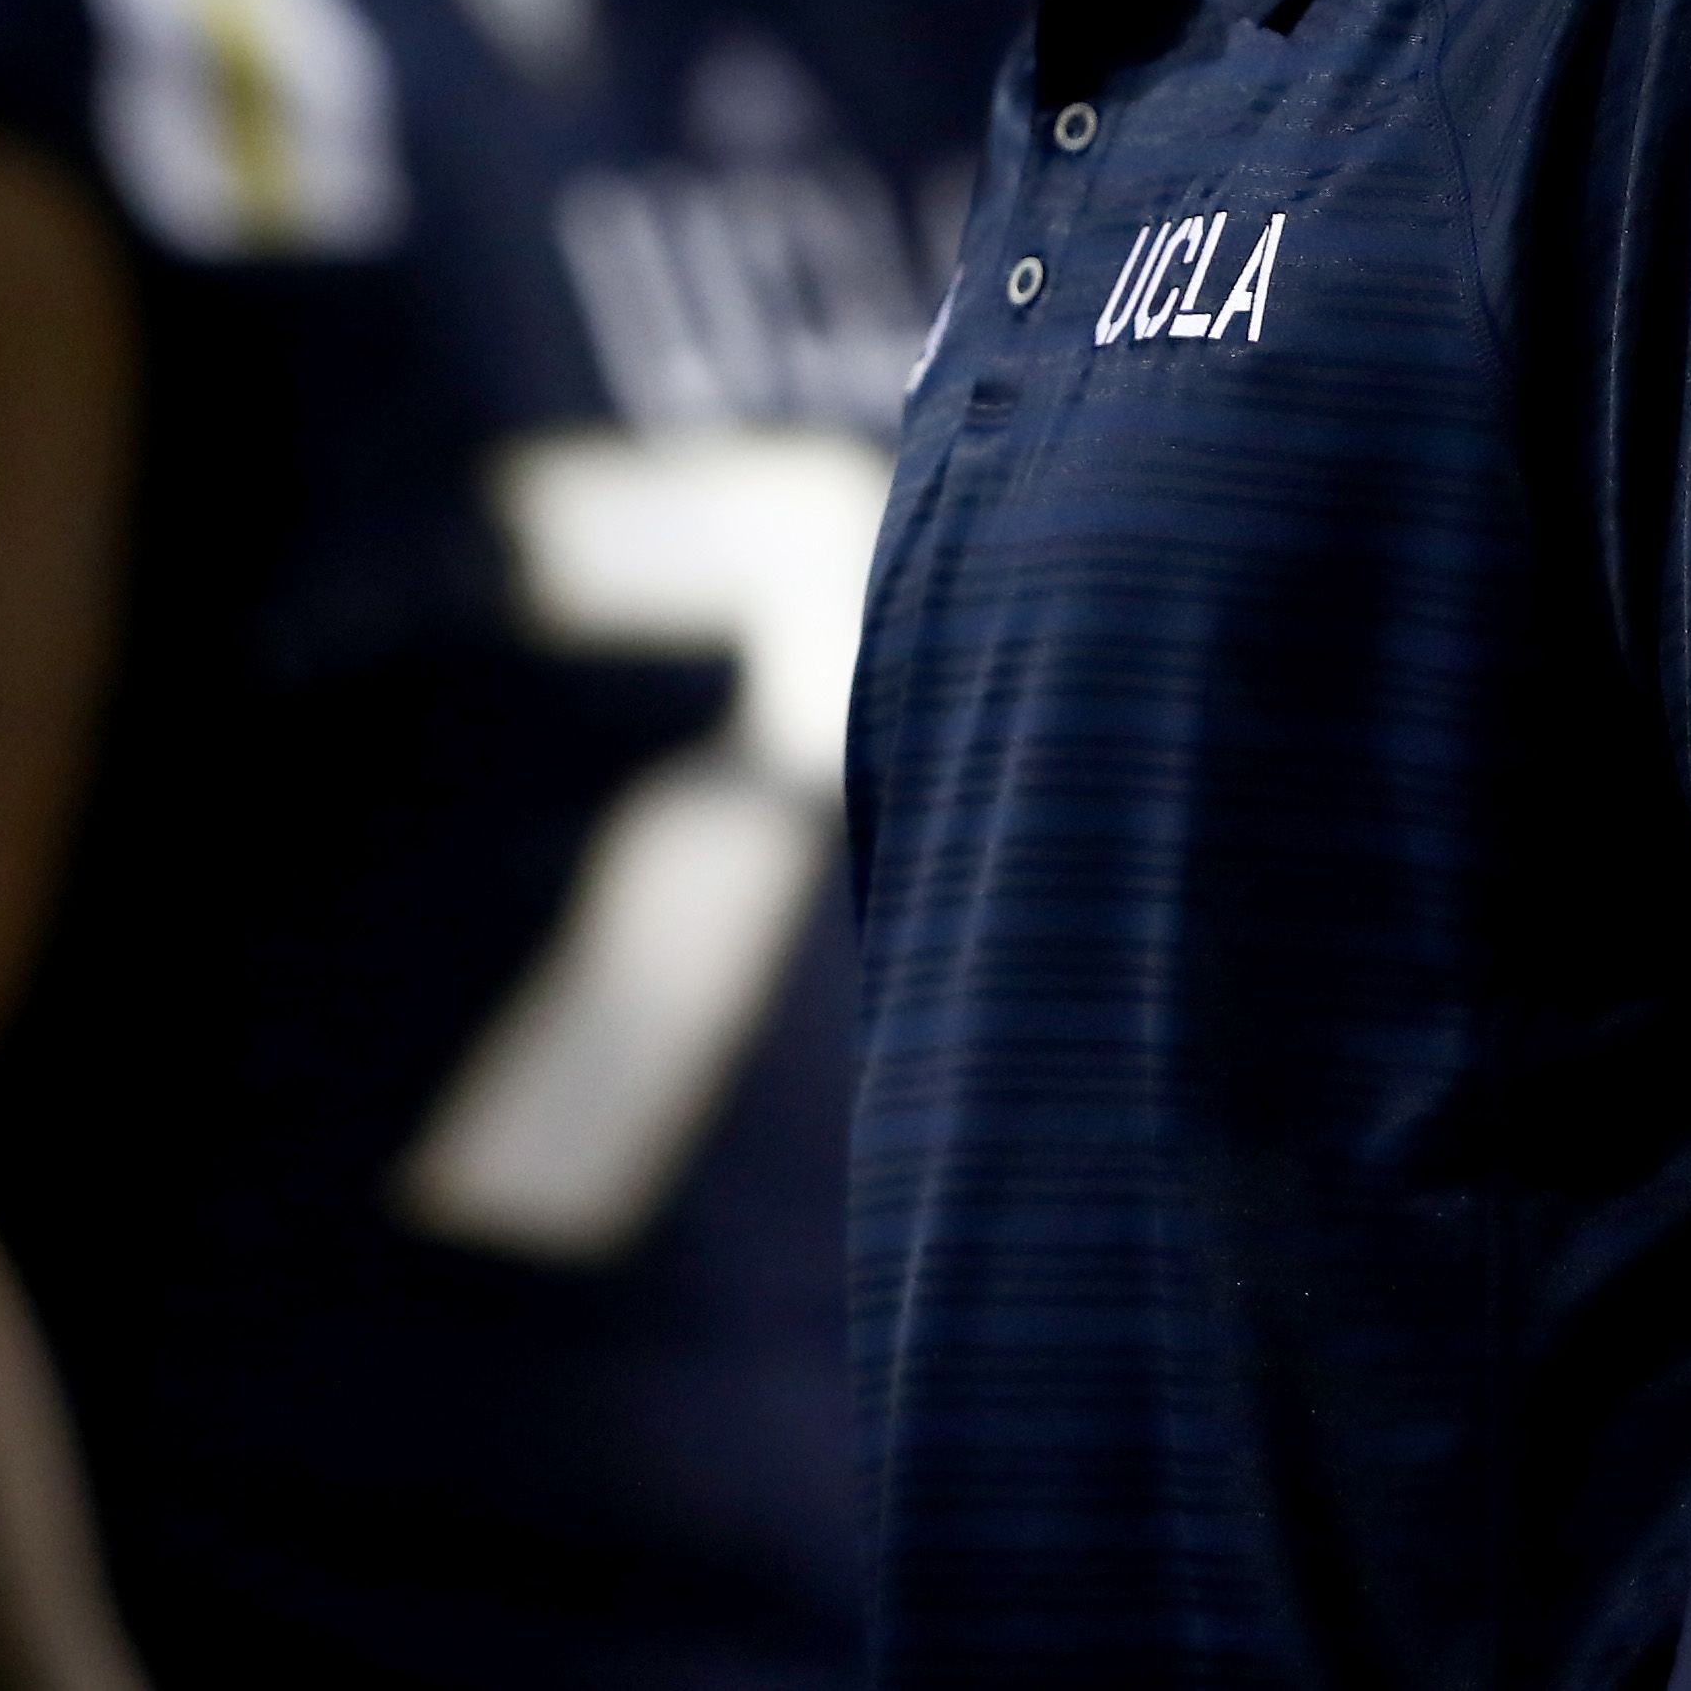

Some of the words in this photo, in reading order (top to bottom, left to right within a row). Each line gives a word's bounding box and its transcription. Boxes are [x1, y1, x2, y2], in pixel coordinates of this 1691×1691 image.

[551, 157, 974, 424] UCL
[1094, 211, 1286, 347] UCLA
[384, 421, 901, 1271] 7
